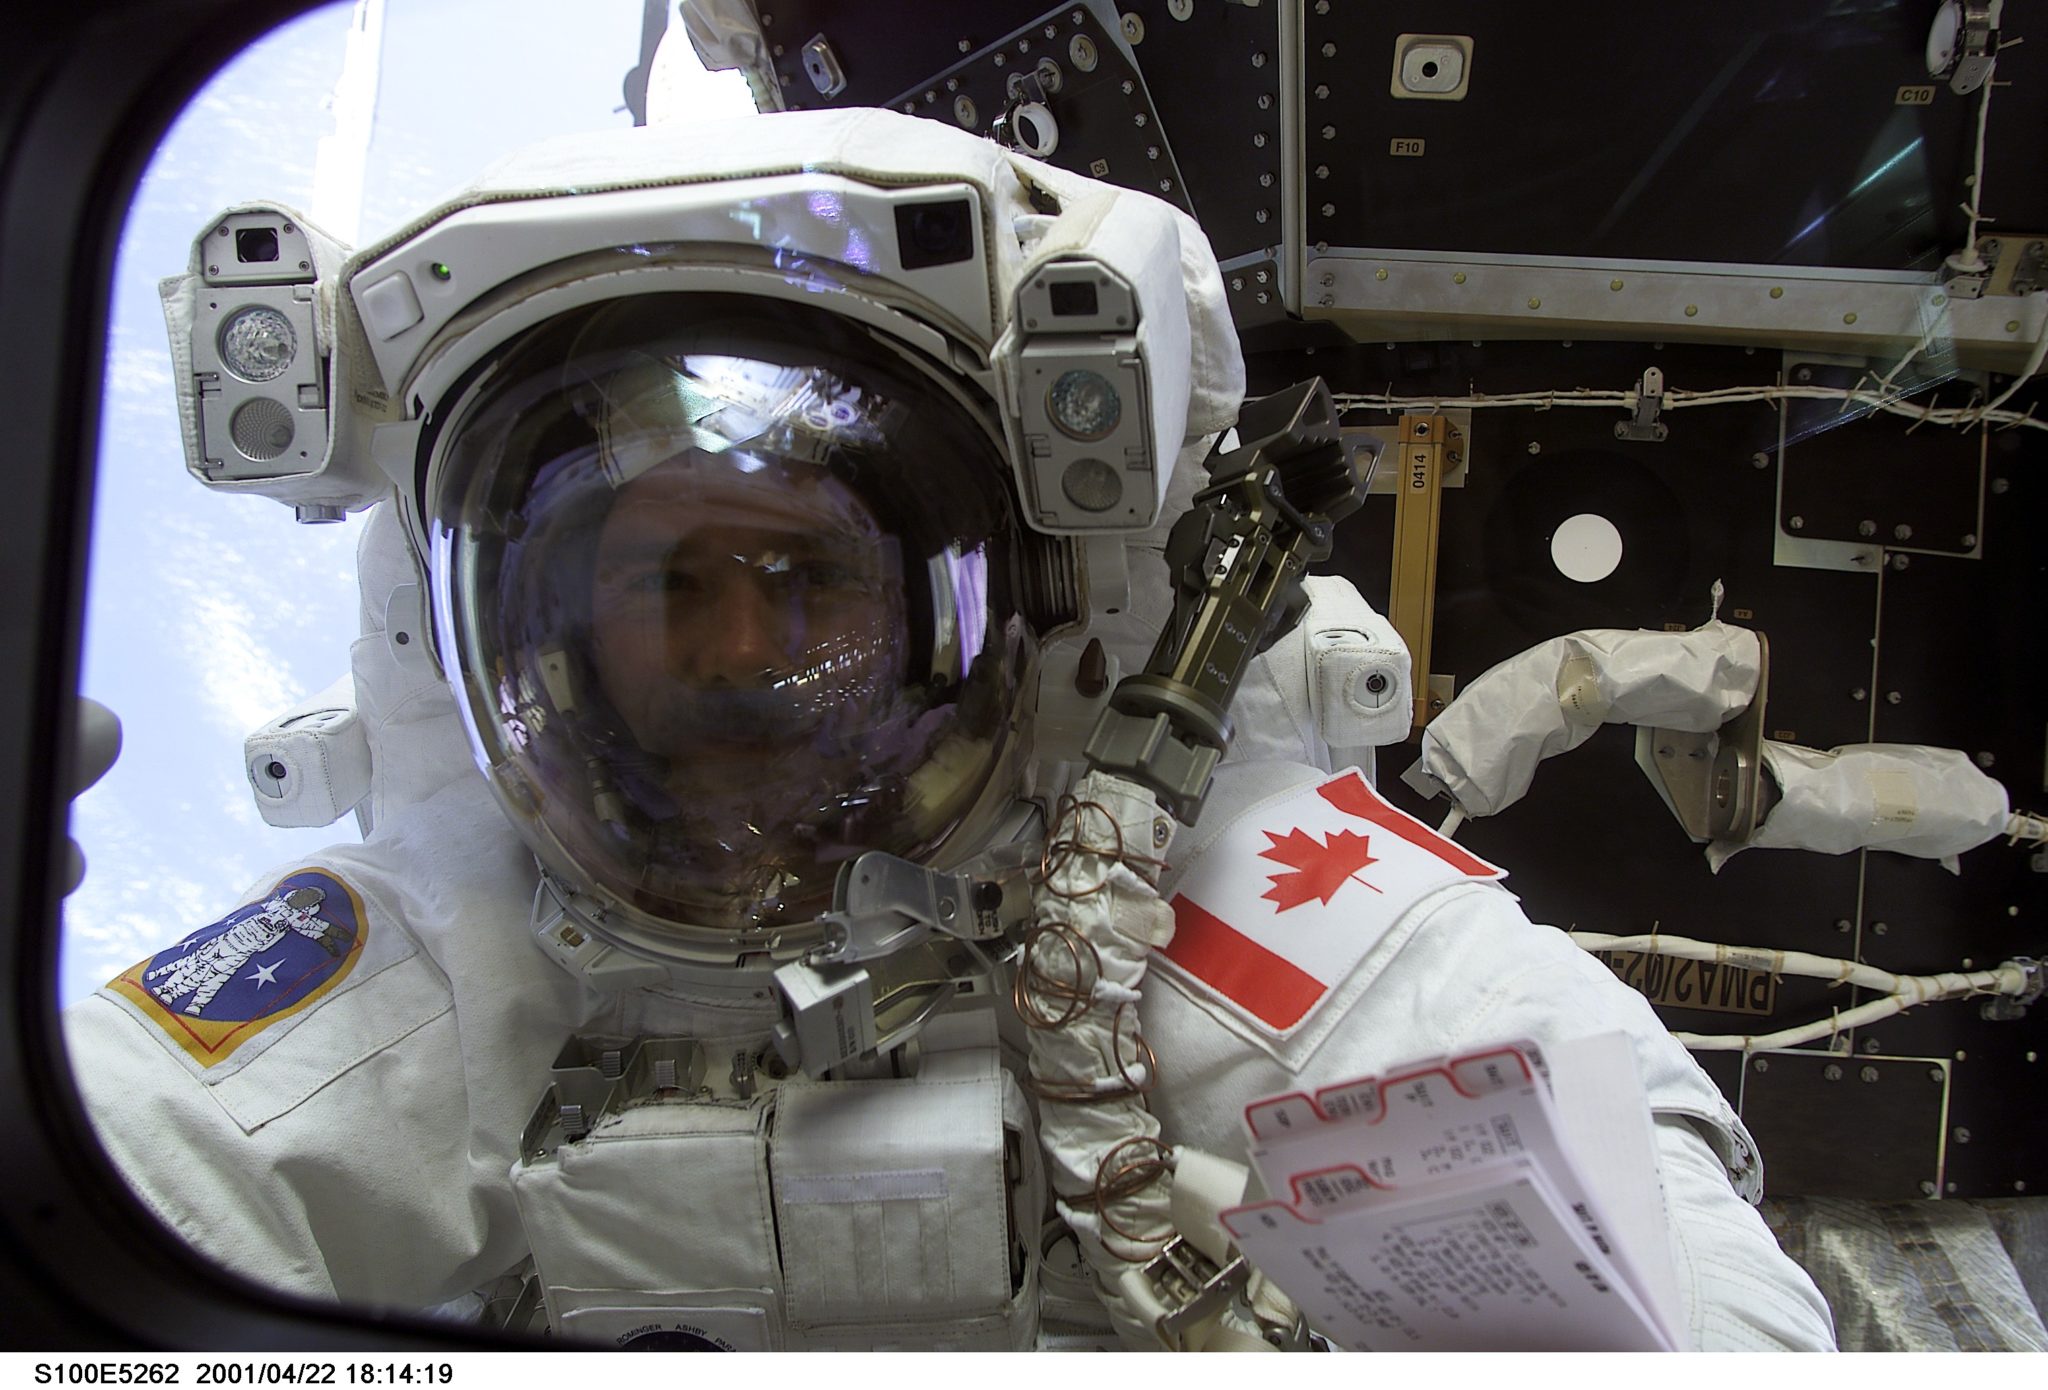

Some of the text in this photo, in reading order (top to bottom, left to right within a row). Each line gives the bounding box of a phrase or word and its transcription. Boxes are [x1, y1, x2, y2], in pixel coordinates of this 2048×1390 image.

[1901, 89, 1930, 102] C10
[1395, 141, 1421, 154] F10
[1412, 454, 1427, 489] 0414
[616, 1324, 662, 1346] ROMINGER
[674, 1323, 708, 1338] ASHBY
